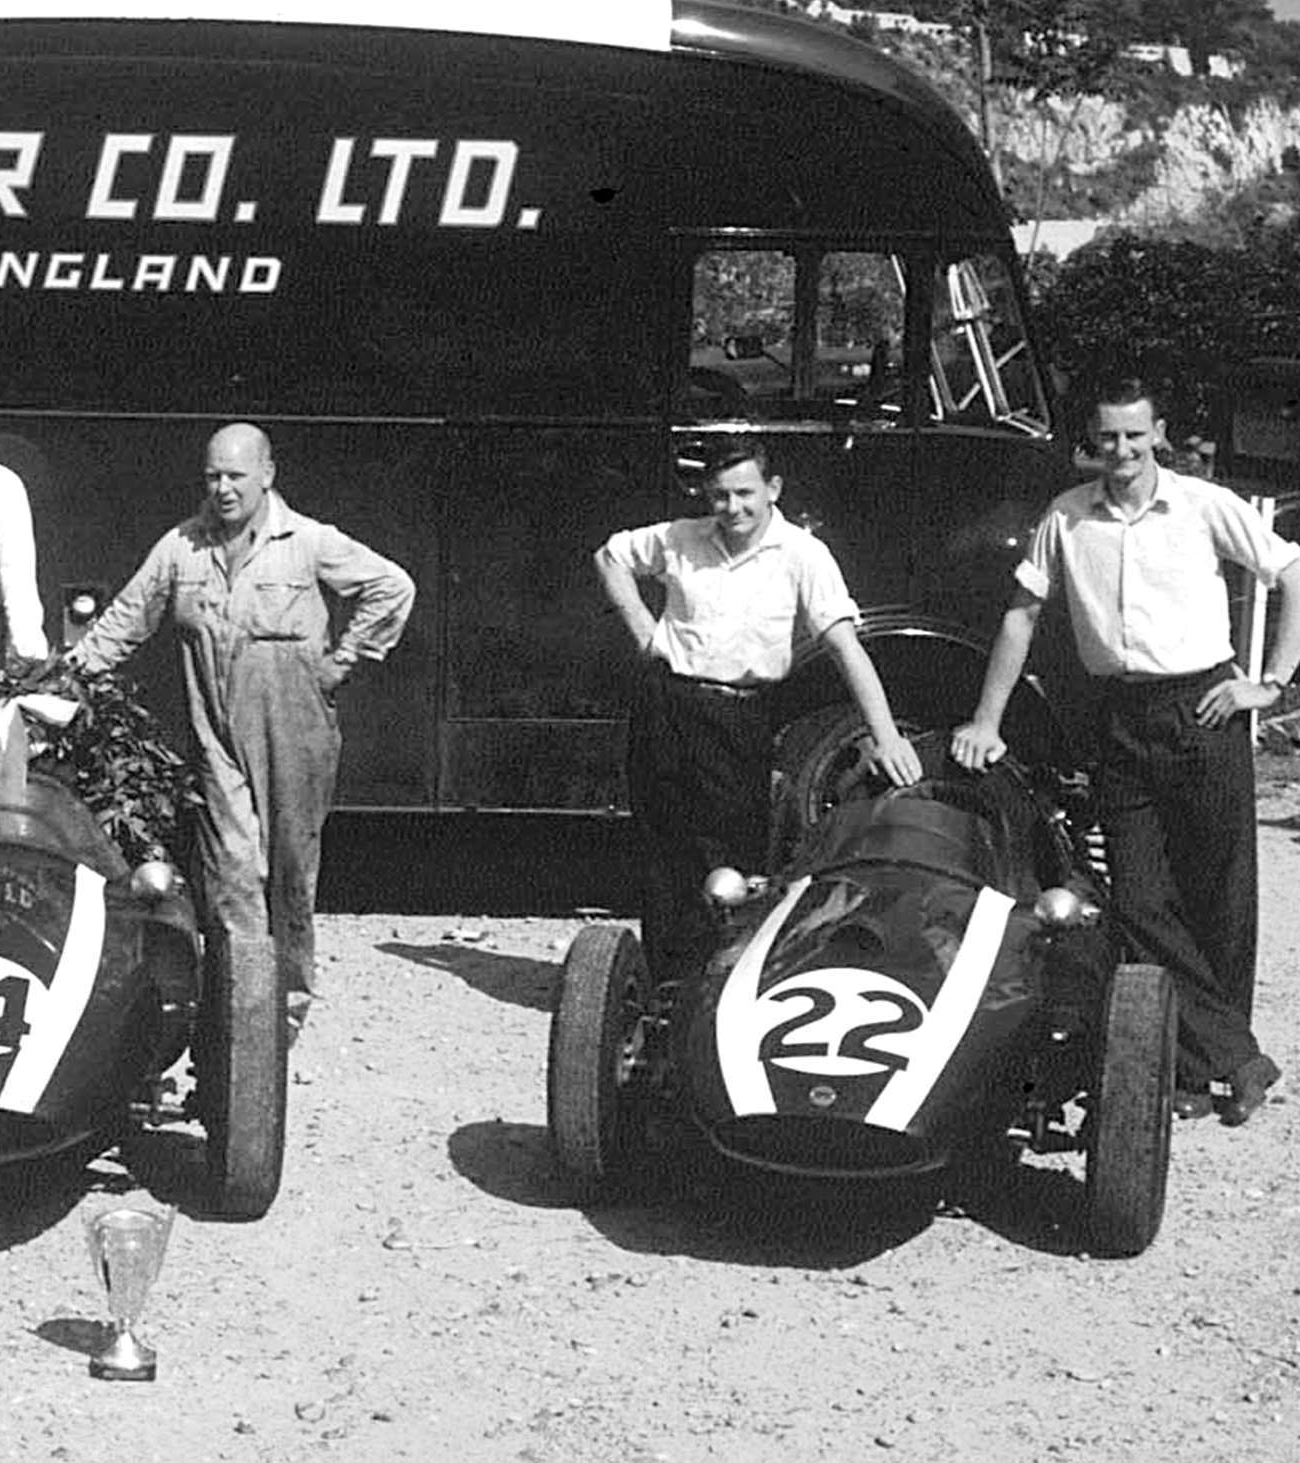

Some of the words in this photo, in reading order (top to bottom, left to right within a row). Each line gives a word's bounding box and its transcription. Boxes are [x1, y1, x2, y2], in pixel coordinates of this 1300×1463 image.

[85, 133, 256, 222] CO.
[316, 137, 541, 228] LTD.
[757, 986, 925, 1072] 22
